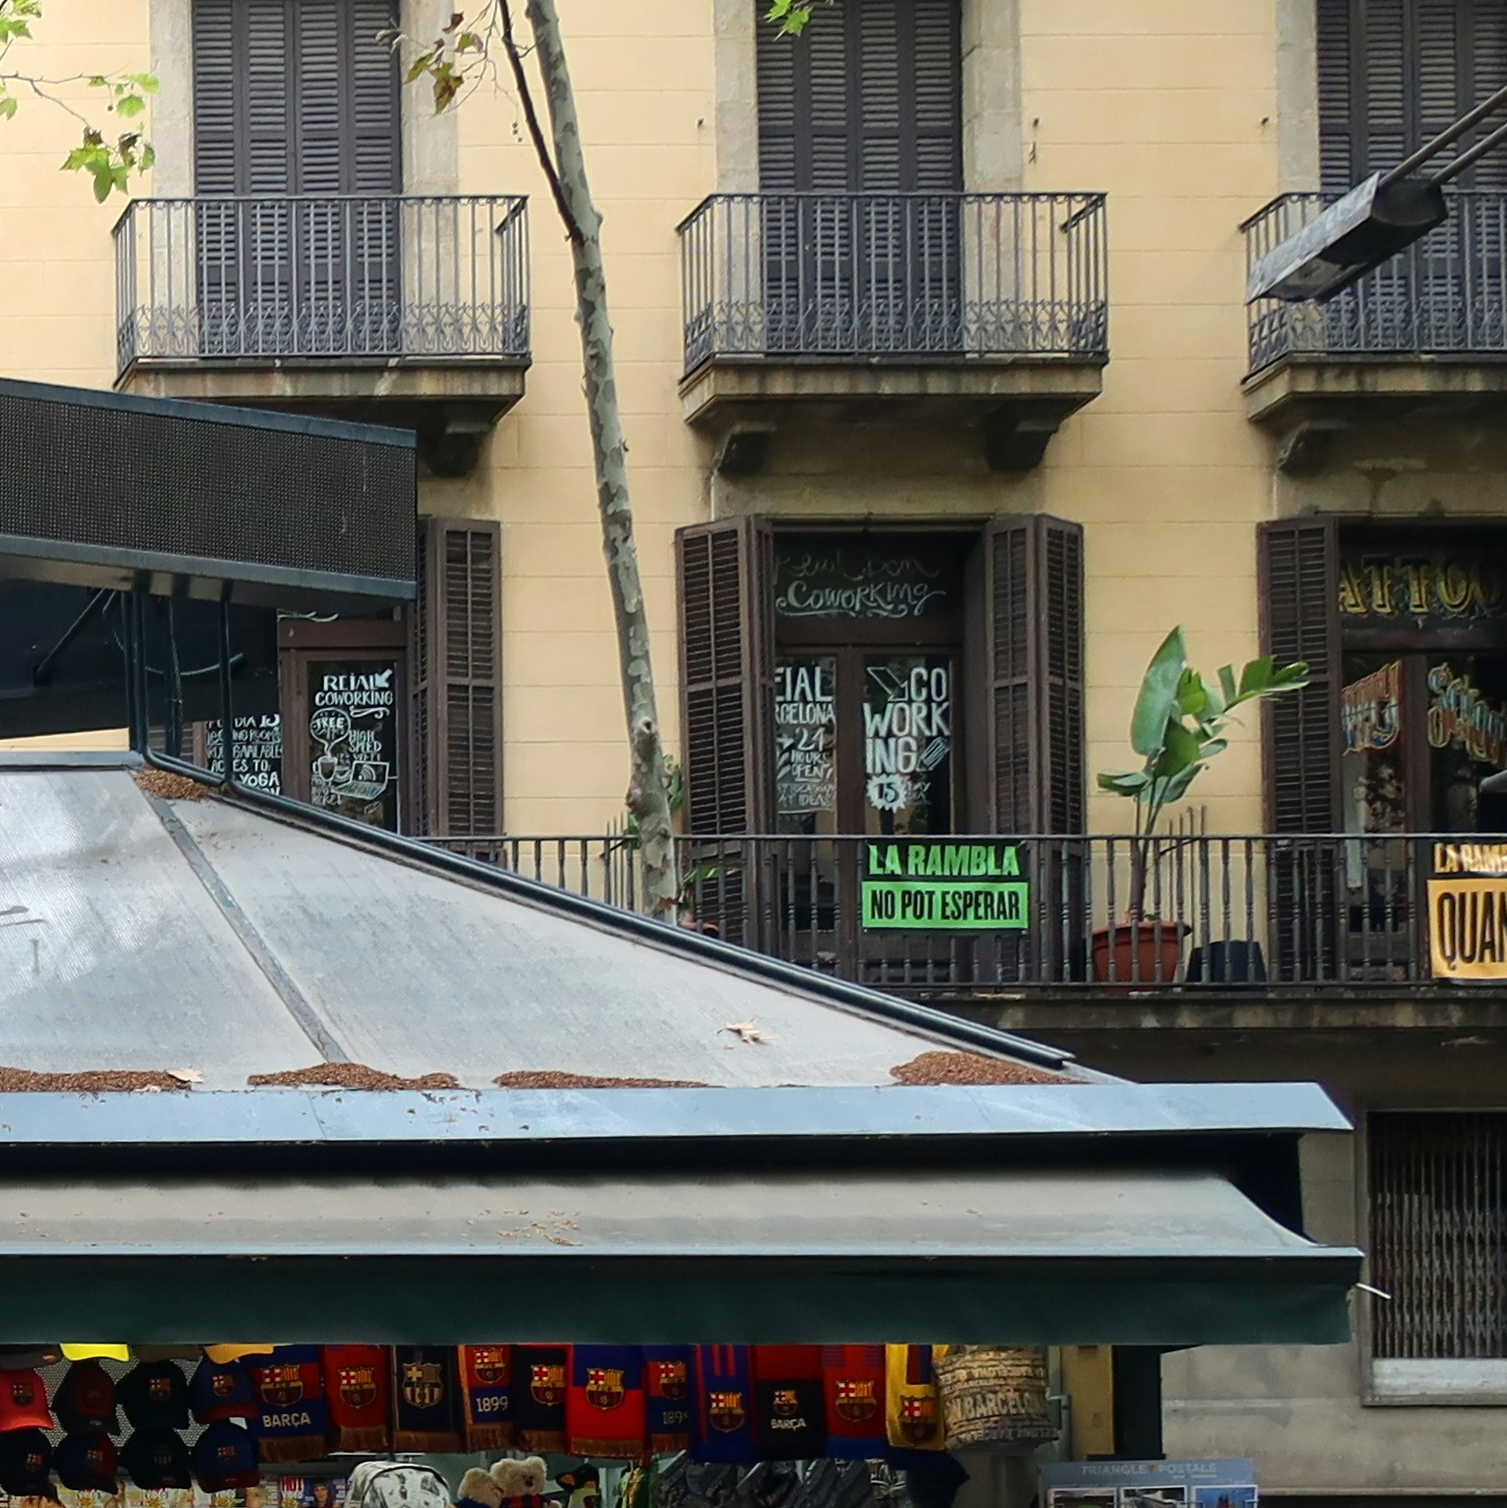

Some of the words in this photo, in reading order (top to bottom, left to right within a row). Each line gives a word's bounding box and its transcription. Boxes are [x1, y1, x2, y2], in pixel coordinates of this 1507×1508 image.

[315, 691, 393, 706] COWORKING
[775, 666, 833, 701] EIAL
[910, 667, 947, 701] CO
[774, 703, 836, 724] RCELONA
[863, 702, 950, 738] WORK
[865, 737, 917, 774] ING
[869, 846, 902, 876] LA
[908, 846, 1020, 876] RAMBLA
[871, 889, 896, 920] NO
[901, 889, 935, 920] POT
[941, 889, 1020, 921] ESPERAR
[262, 1412, 312, 1429] BARÇA
[770, 1417, 807, 1431] BARÇA
